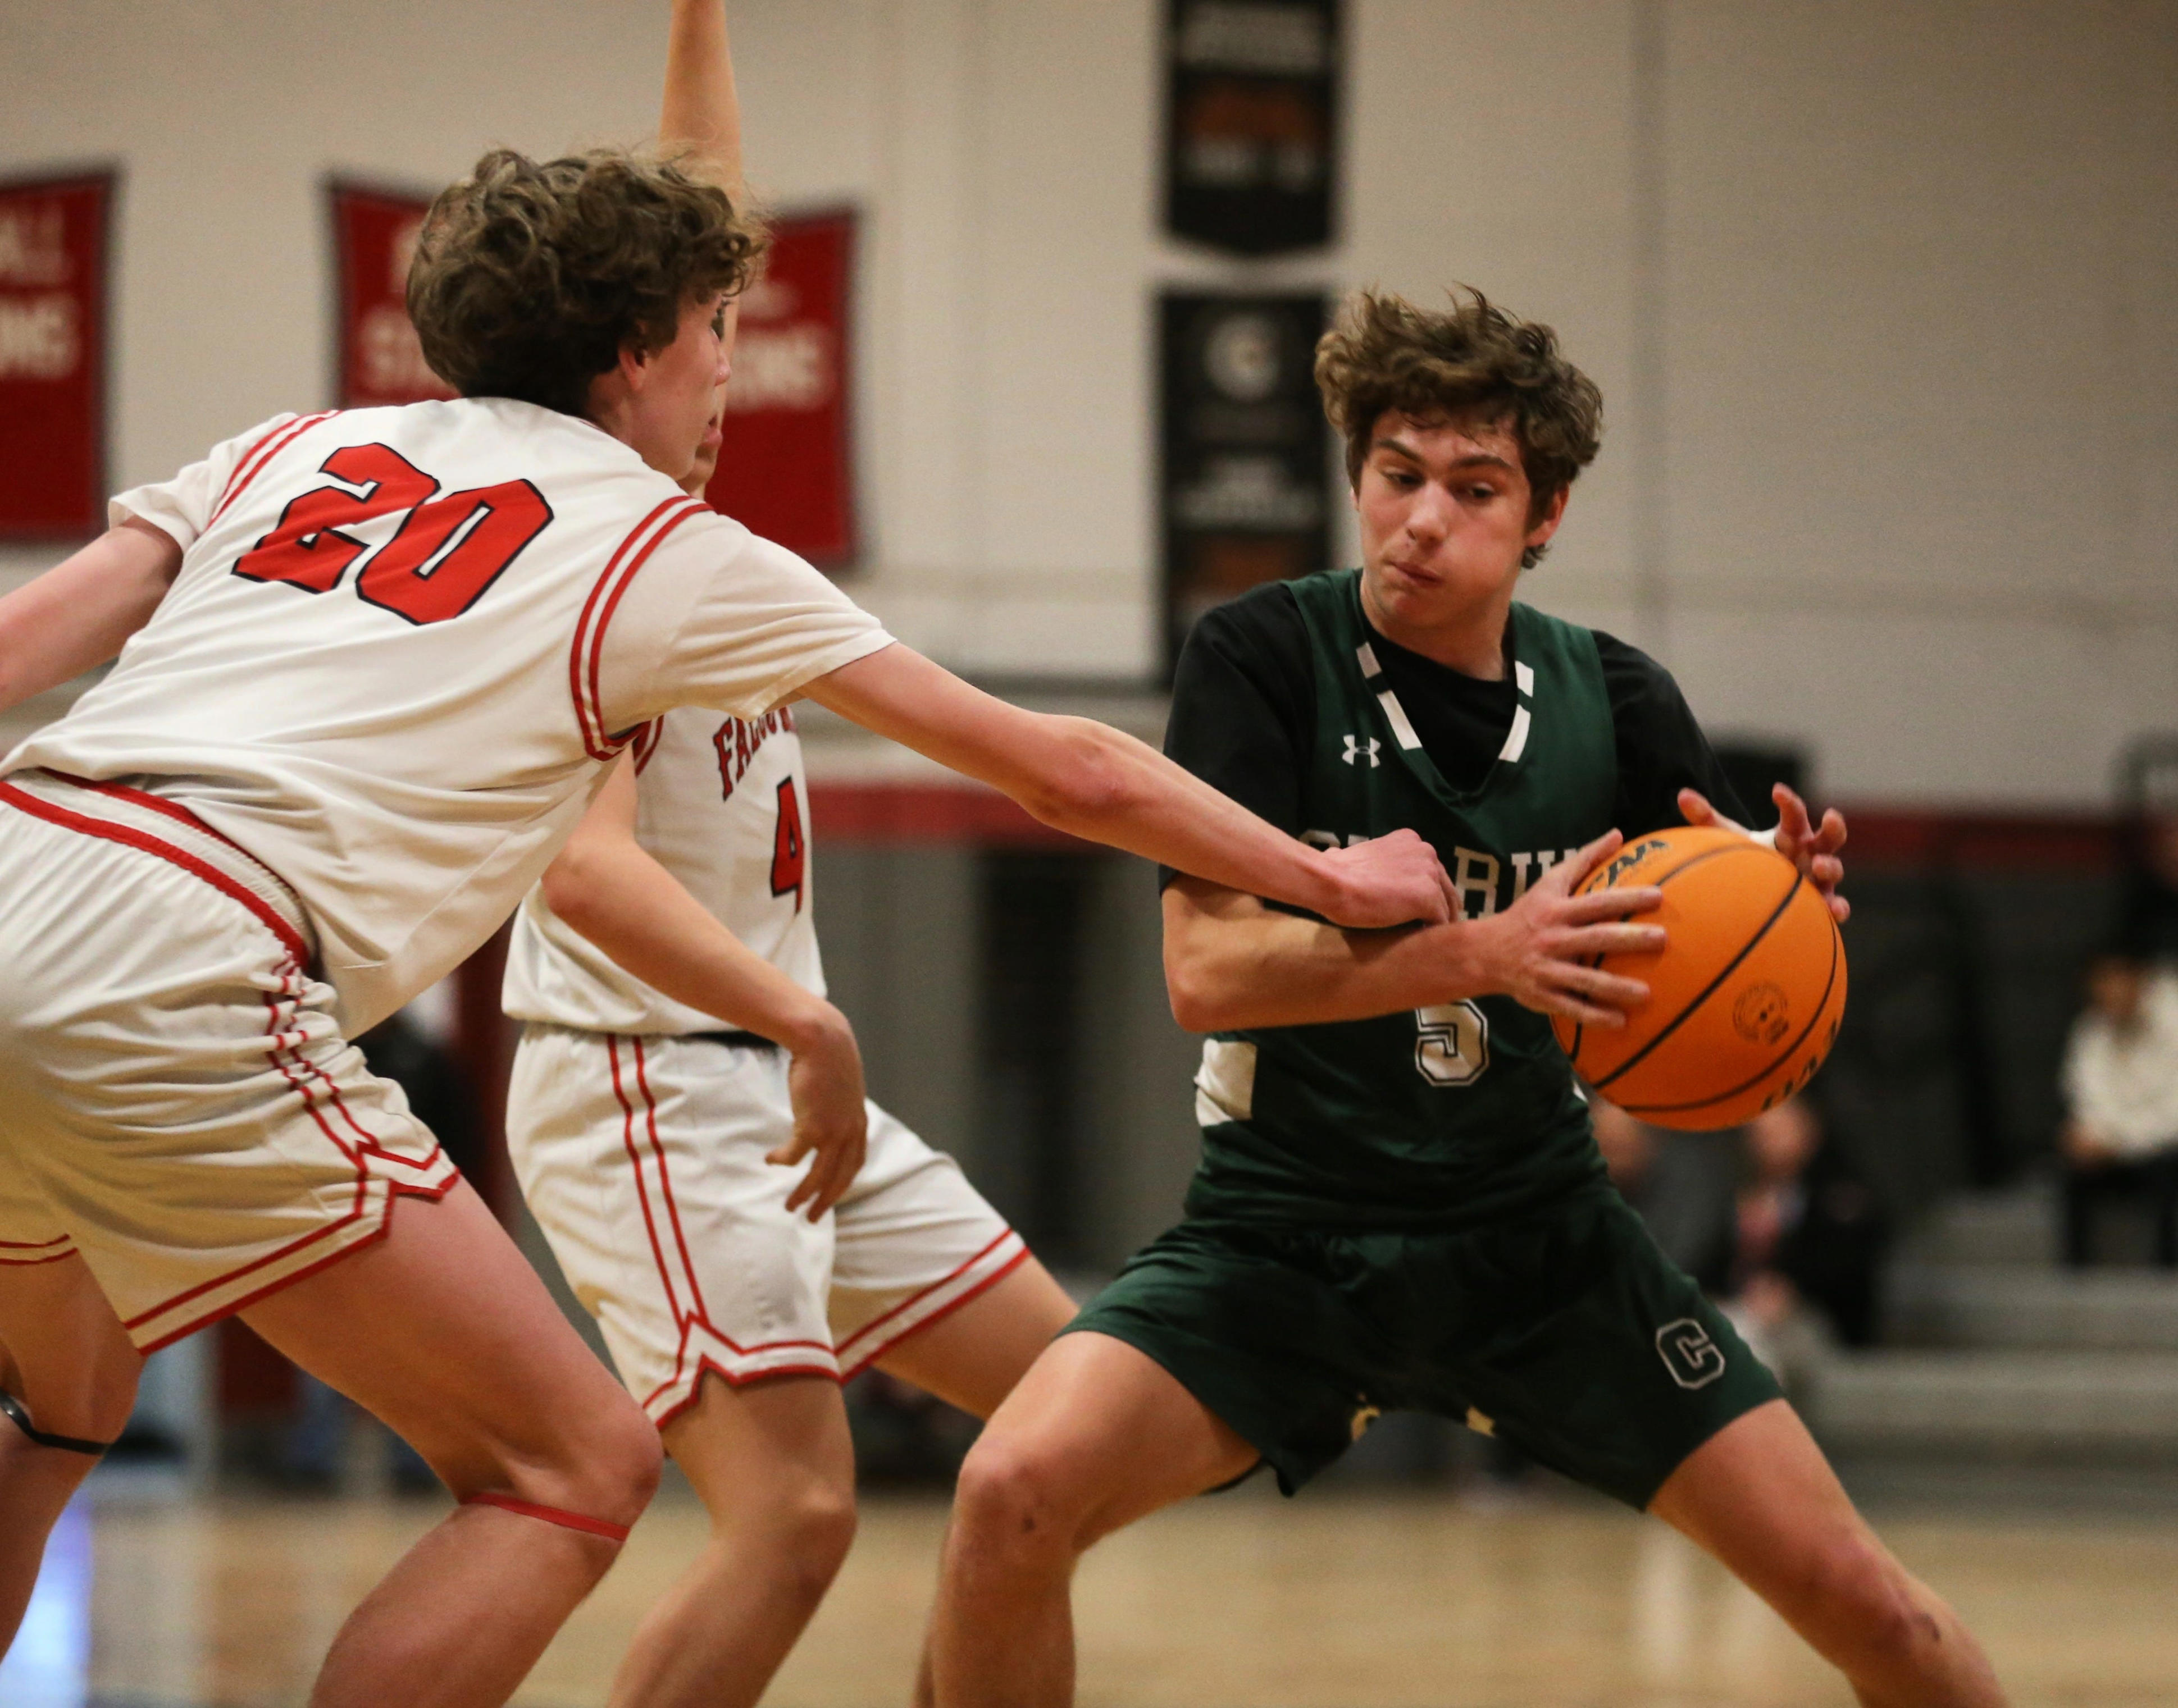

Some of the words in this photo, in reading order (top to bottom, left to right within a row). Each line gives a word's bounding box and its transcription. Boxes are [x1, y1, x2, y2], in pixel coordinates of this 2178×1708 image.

[230, 441, 555, 627] 20
[770, 774, 805, 919] 4
[1414, 997, 1489, 1086] 5
[1655, 1317, 1726, 1390] C
